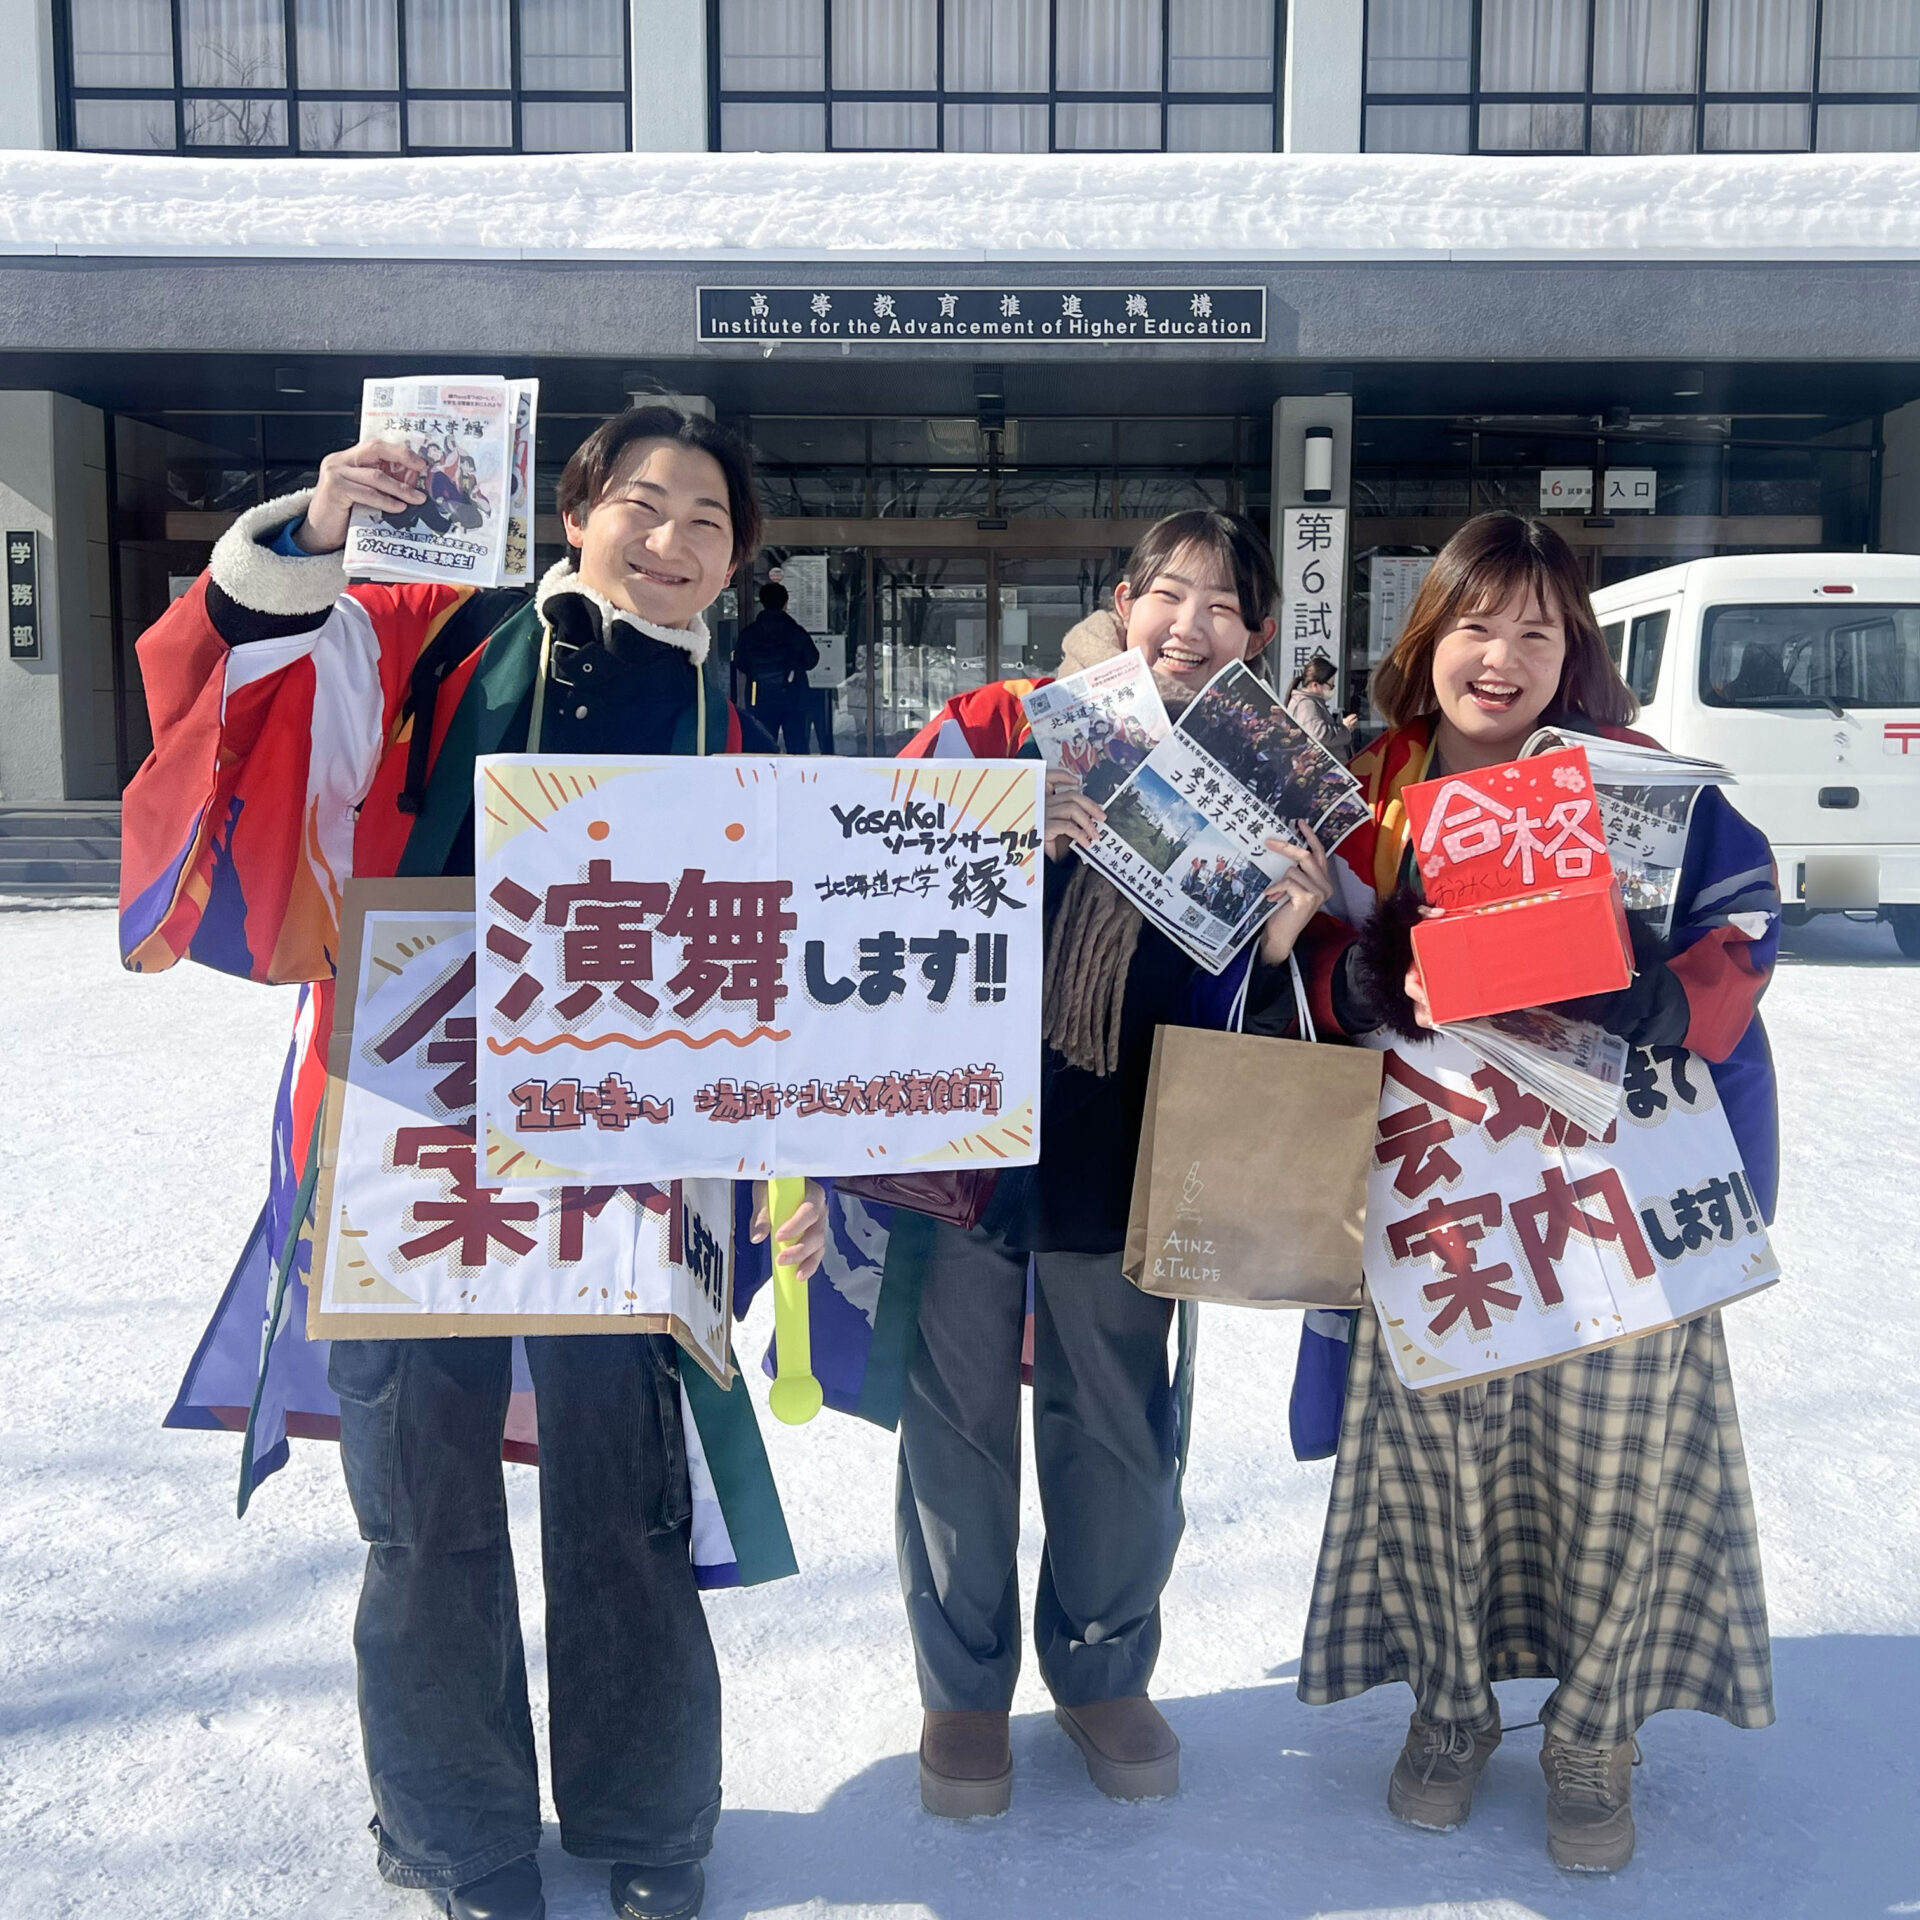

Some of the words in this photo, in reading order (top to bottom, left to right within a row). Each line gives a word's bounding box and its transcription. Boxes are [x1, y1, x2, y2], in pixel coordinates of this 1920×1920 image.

[711, 319, 802, 334] Institute
[810, 319, 840, 334] for
[848, 319, 881, 334] the
[888, 319, 1034, 334] Advancement
[1041, 319, 1062, 334] of
[1069, 319, 1137, 337] Higher
[1144, 319, 1251, 334] Education
[750, 293, 1213, 318] 高等教育推進機構
[1610, 482, 1649, 497] 入口
[11, 542, 34, 648] 学務部
[1293, 513, 1333, 690] 第6試験
[1170, 770, 1267, 857] コラボステージ
[1189, 767, 1264, 839] 受験生応援
[1420, 779, 1607, 885] 合格
[882, 828, 1043, 855] ソーランサークル
[1088, 838, 1165, 908] 所:北大体育館前
[1433, 866, 1518, 906] おみくじ
